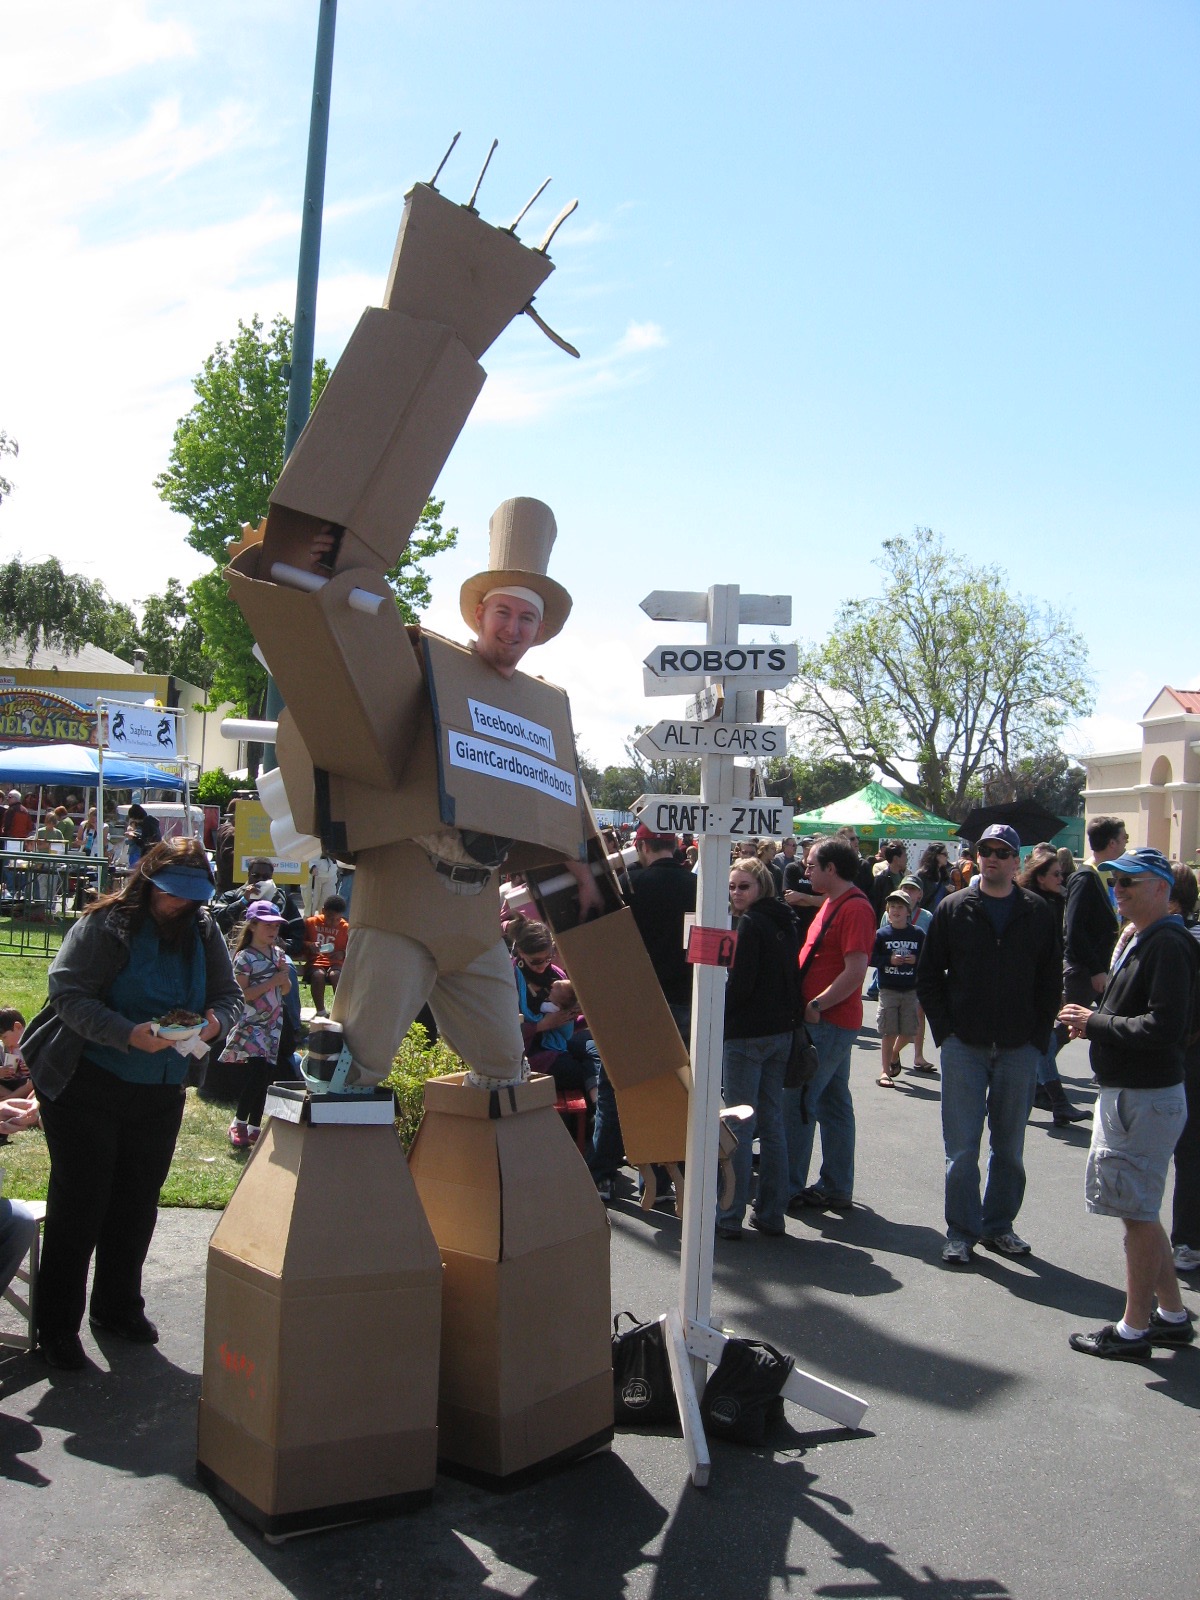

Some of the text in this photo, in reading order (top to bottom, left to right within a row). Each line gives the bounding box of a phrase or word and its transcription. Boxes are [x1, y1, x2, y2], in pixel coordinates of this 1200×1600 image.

[660, 649, 786, 671] ROBOTS
[31, 717, 89, 741] CAKES
[664, 724, 777, 751] ALT. CARS
[456, 740, 572, 796] GiantCardboardRobots
[730, 807, 782, 835] ZINE
[280, 861, 299, 869] SHED
[885, 940, 918, 950] TOWN
[884, 966, 914, 976] SCH
